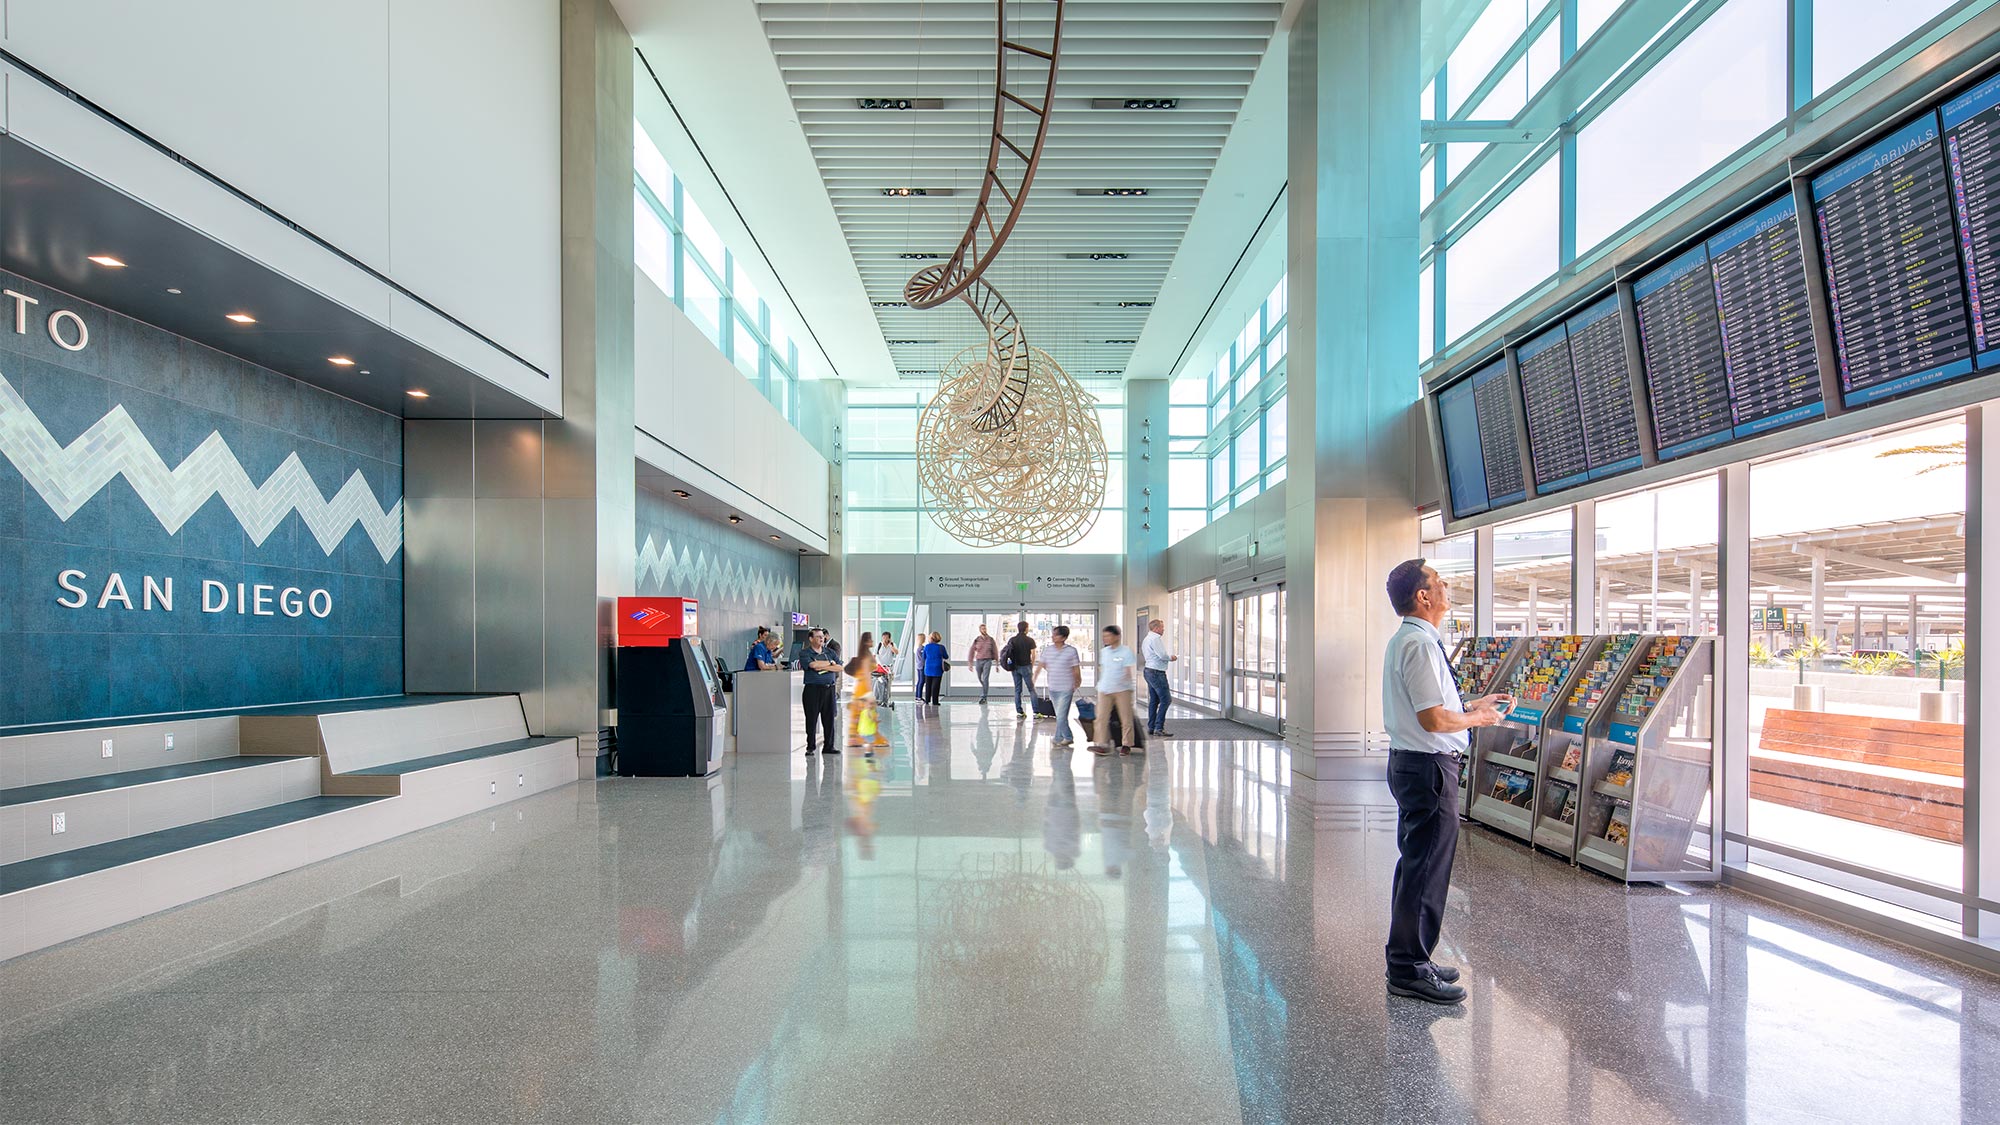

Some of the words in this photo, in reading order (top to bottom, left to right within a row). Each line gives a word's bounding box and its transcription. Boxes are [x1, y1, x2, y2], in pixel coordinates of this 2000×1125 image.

[1957, 118, 1974, 131] ORIGIN
[1872, 127, 1933, 169] ARRIVALS
[1890, 156, 1904, 167] STATUS
[1918, 141, 1932, 152] CLAIM
[1754, 204, 1794, 234] ARRIVAL
[3, 289, 88, 351] TO
[1868, 385, 1892, 397] Wednesday
[1933, 370, 1943, 378] AM
[56, 569, 173, 611] SAN
[202, 580, 333, 618] DIEGO
[1767, 610, 1777, 618] P1
